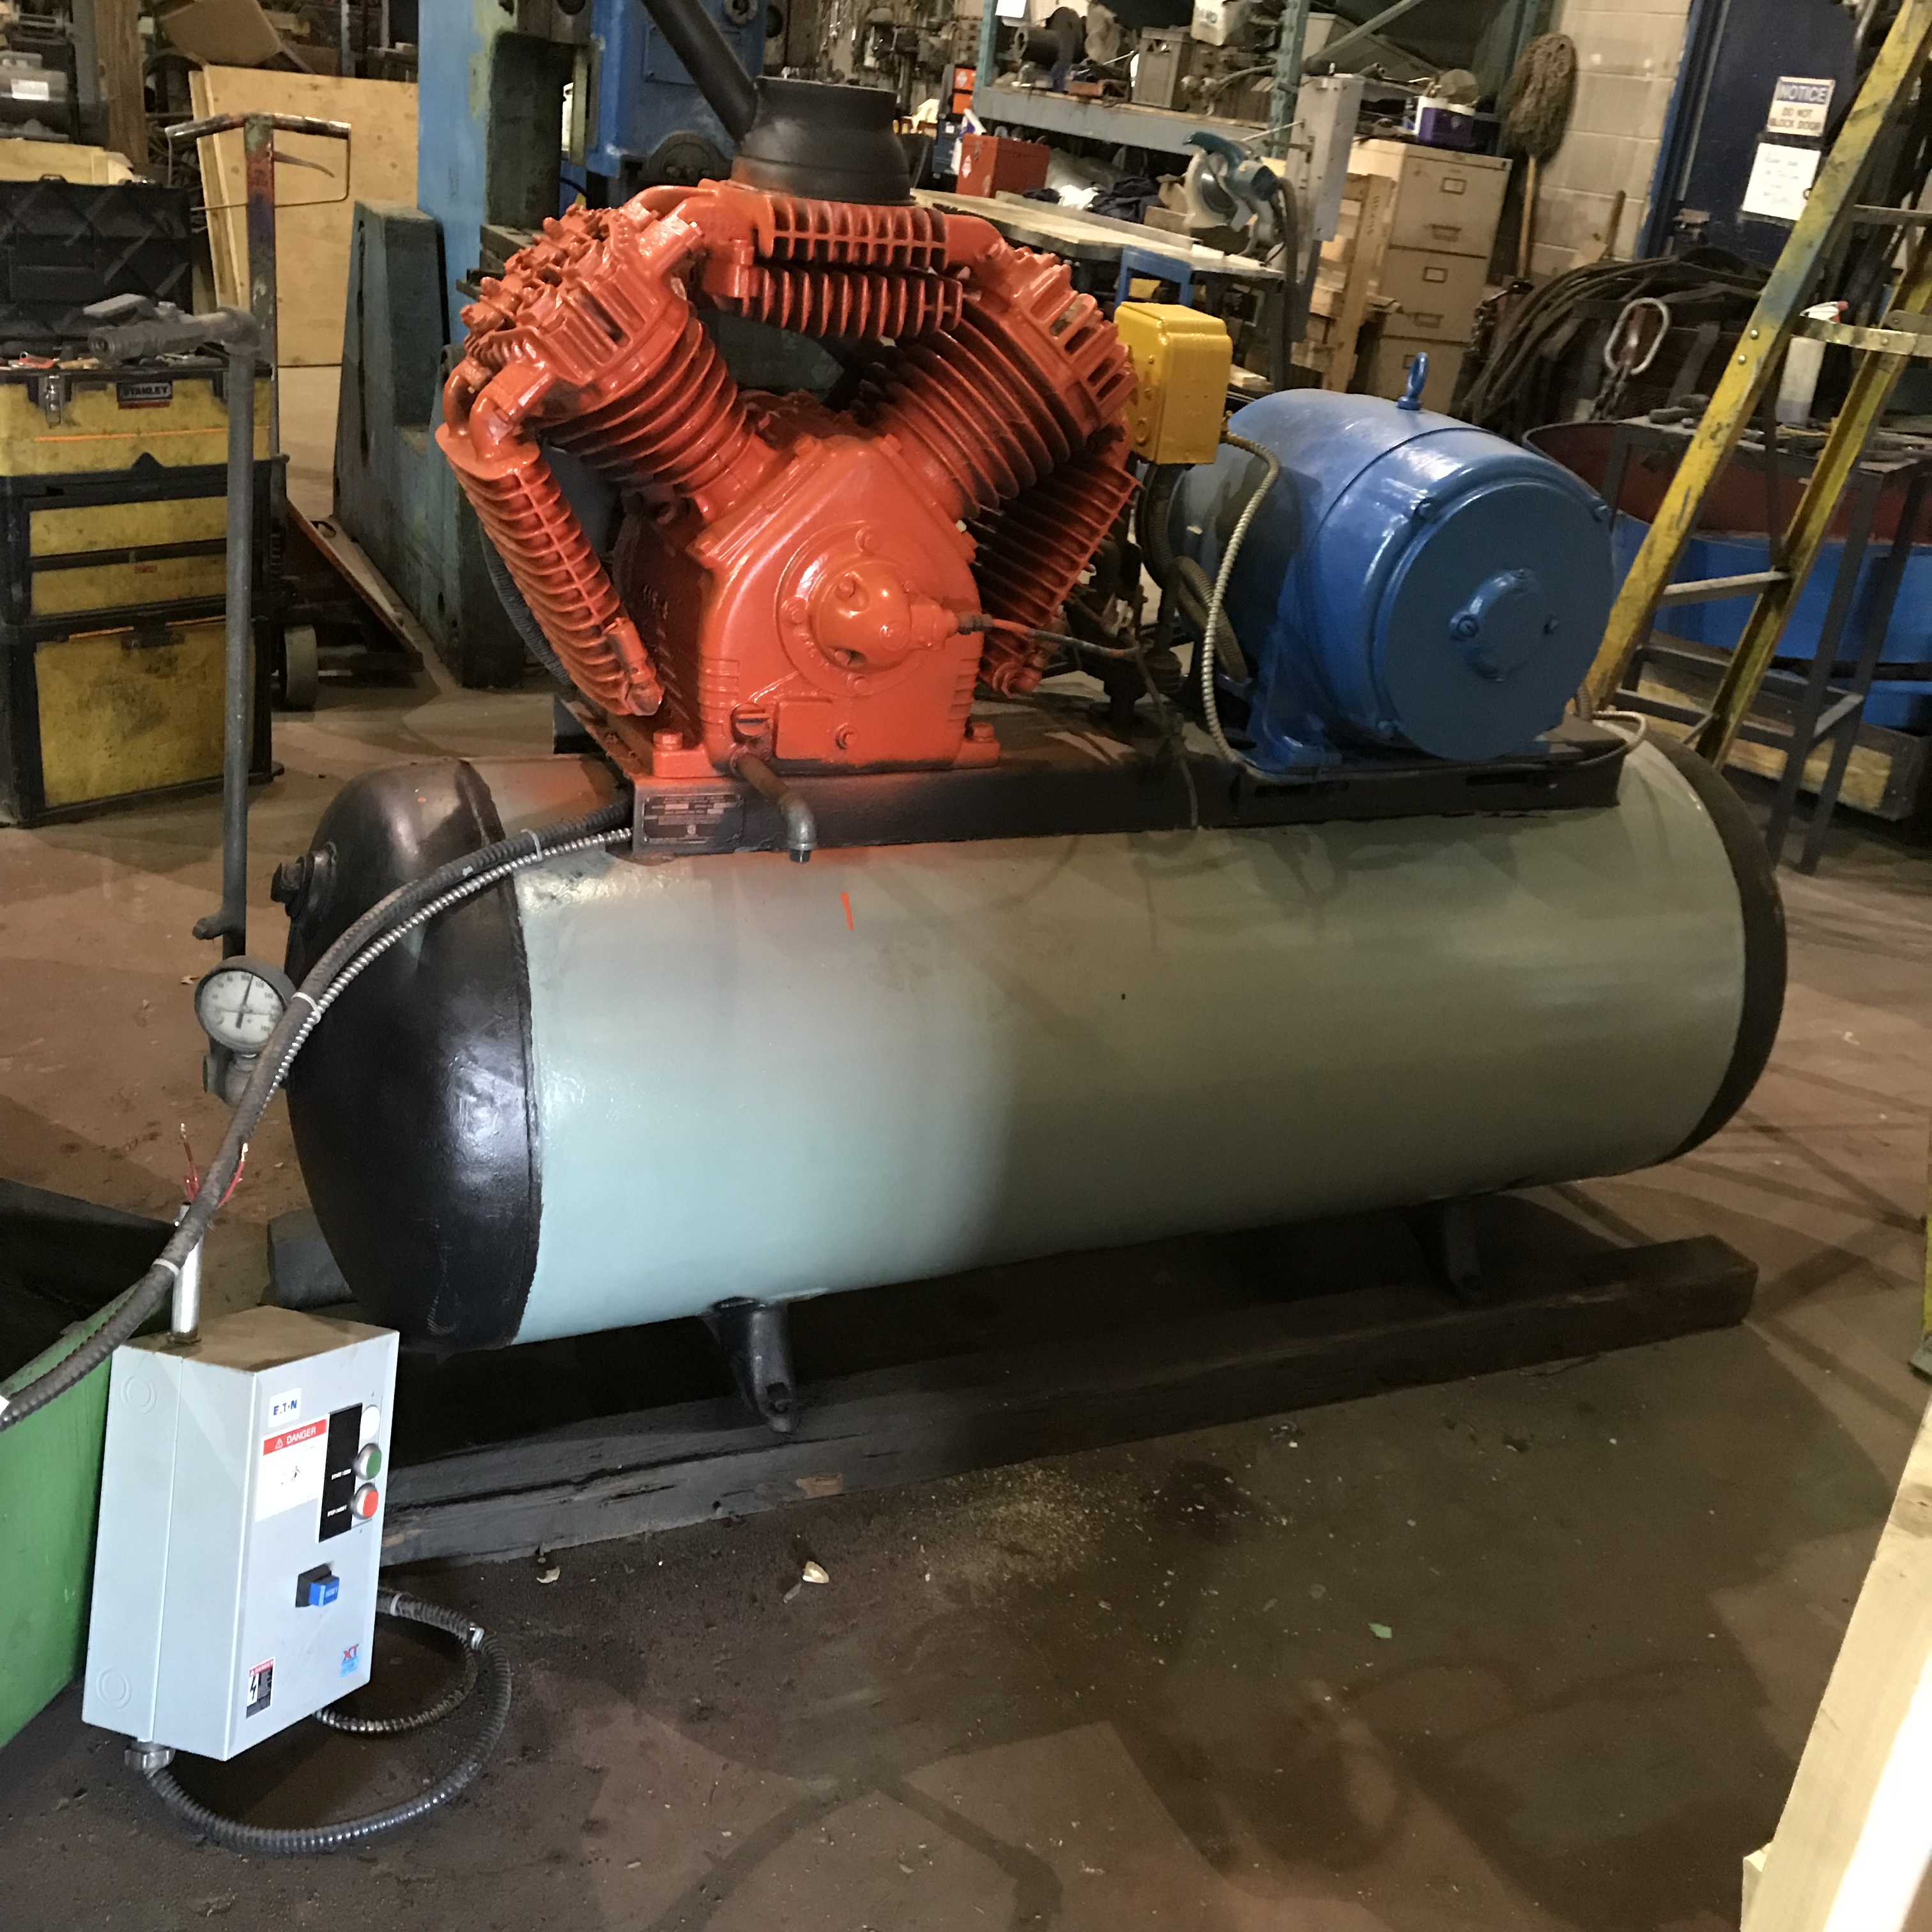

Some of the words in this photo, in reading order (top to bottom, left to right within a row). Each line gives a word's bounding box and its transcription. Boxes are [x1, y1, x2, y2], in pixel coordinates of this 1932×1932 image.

[1779, 84, 1828, 102] NOTICE
[121, 386, 168, 397] STANLEY
[286, 1426, 316, 1445] DANGER
